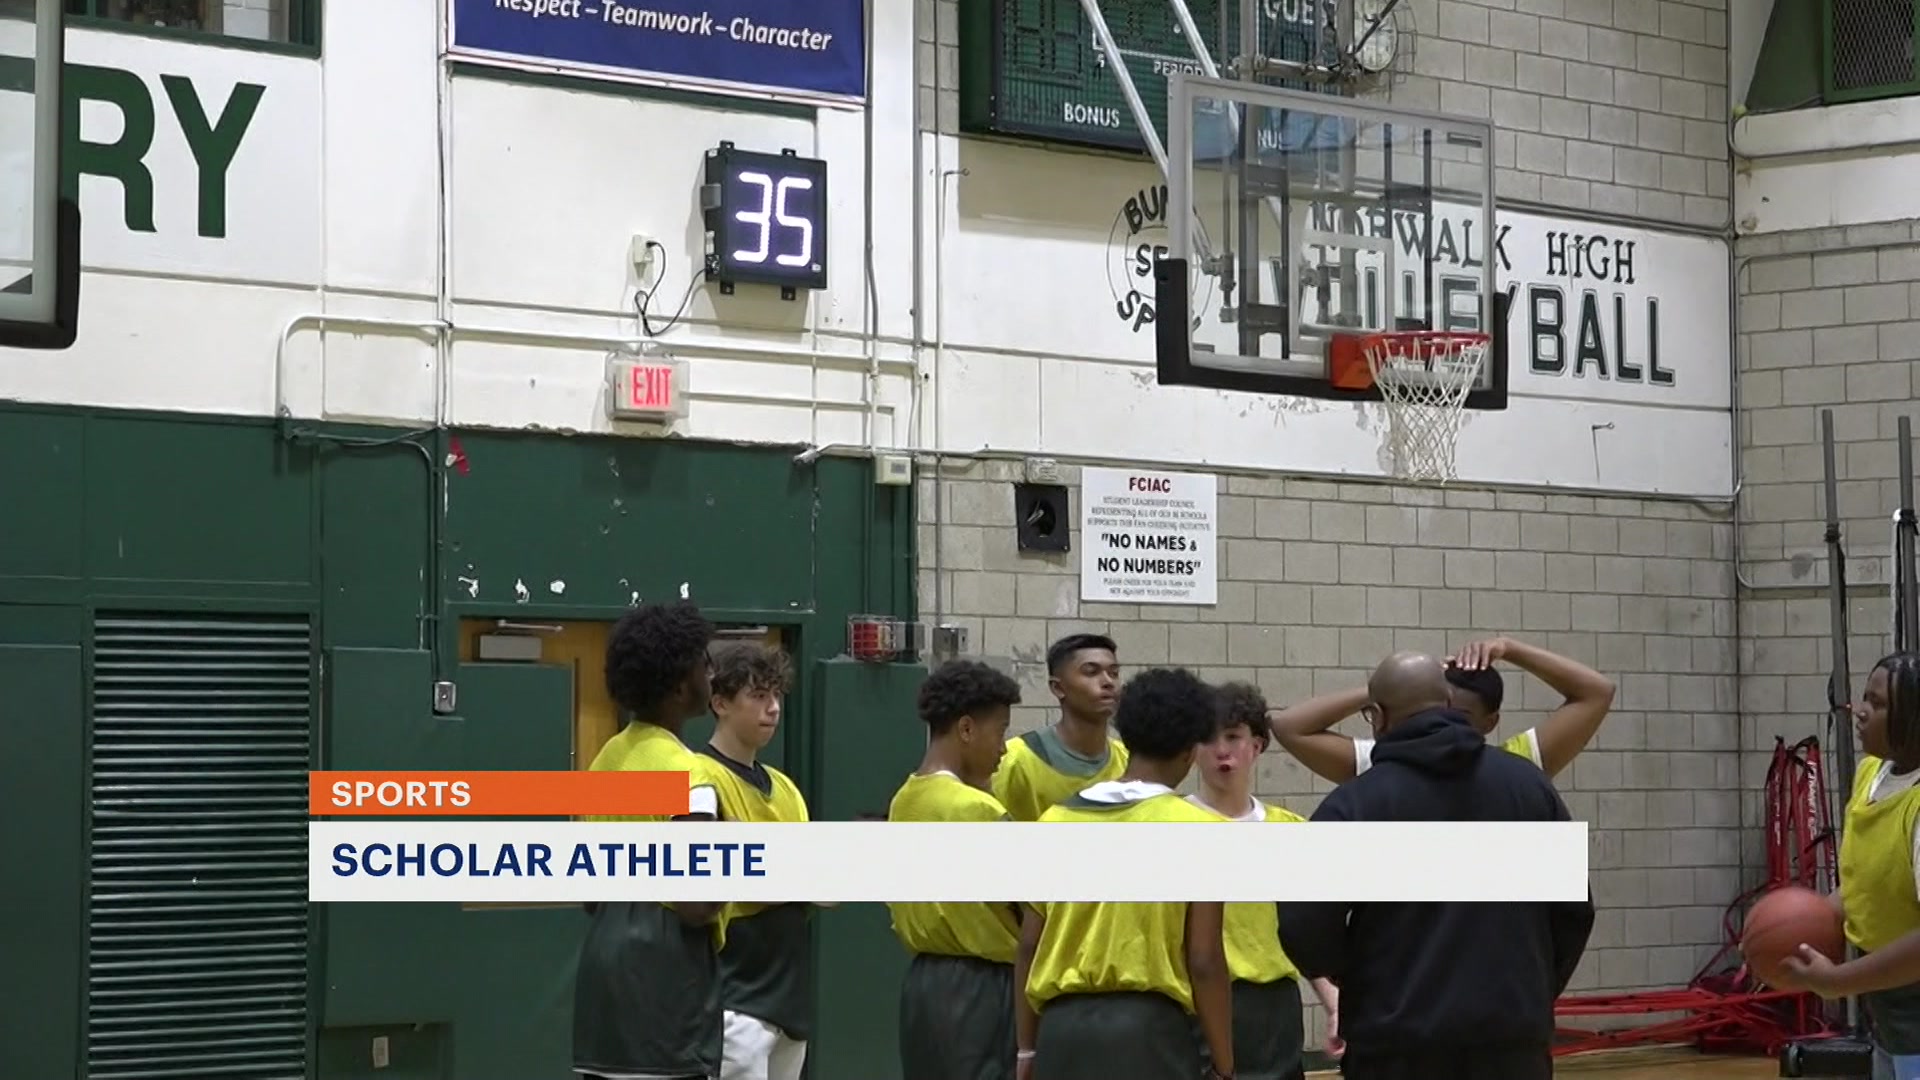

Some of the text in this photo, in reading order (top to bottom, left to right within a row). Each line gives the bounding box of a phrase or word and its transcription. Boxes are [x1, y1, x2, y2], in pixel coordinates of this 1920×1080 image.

[603, 1, 713, 36] Teamwork
[730, 17, 832, 50] Character
[1064, 103, 1120, 128] BONUS
[733, 171, 812, 267] 35
[1546, 231, 1636, 285] HIGH
[633, 367, 672, 406] EXIT
[1129, 477, 1171, 493] FCIAC
[1101, 533, 1197, 551] "NO NAMES &
[1098, 557, 1201, 575] NO NUMBERS"
